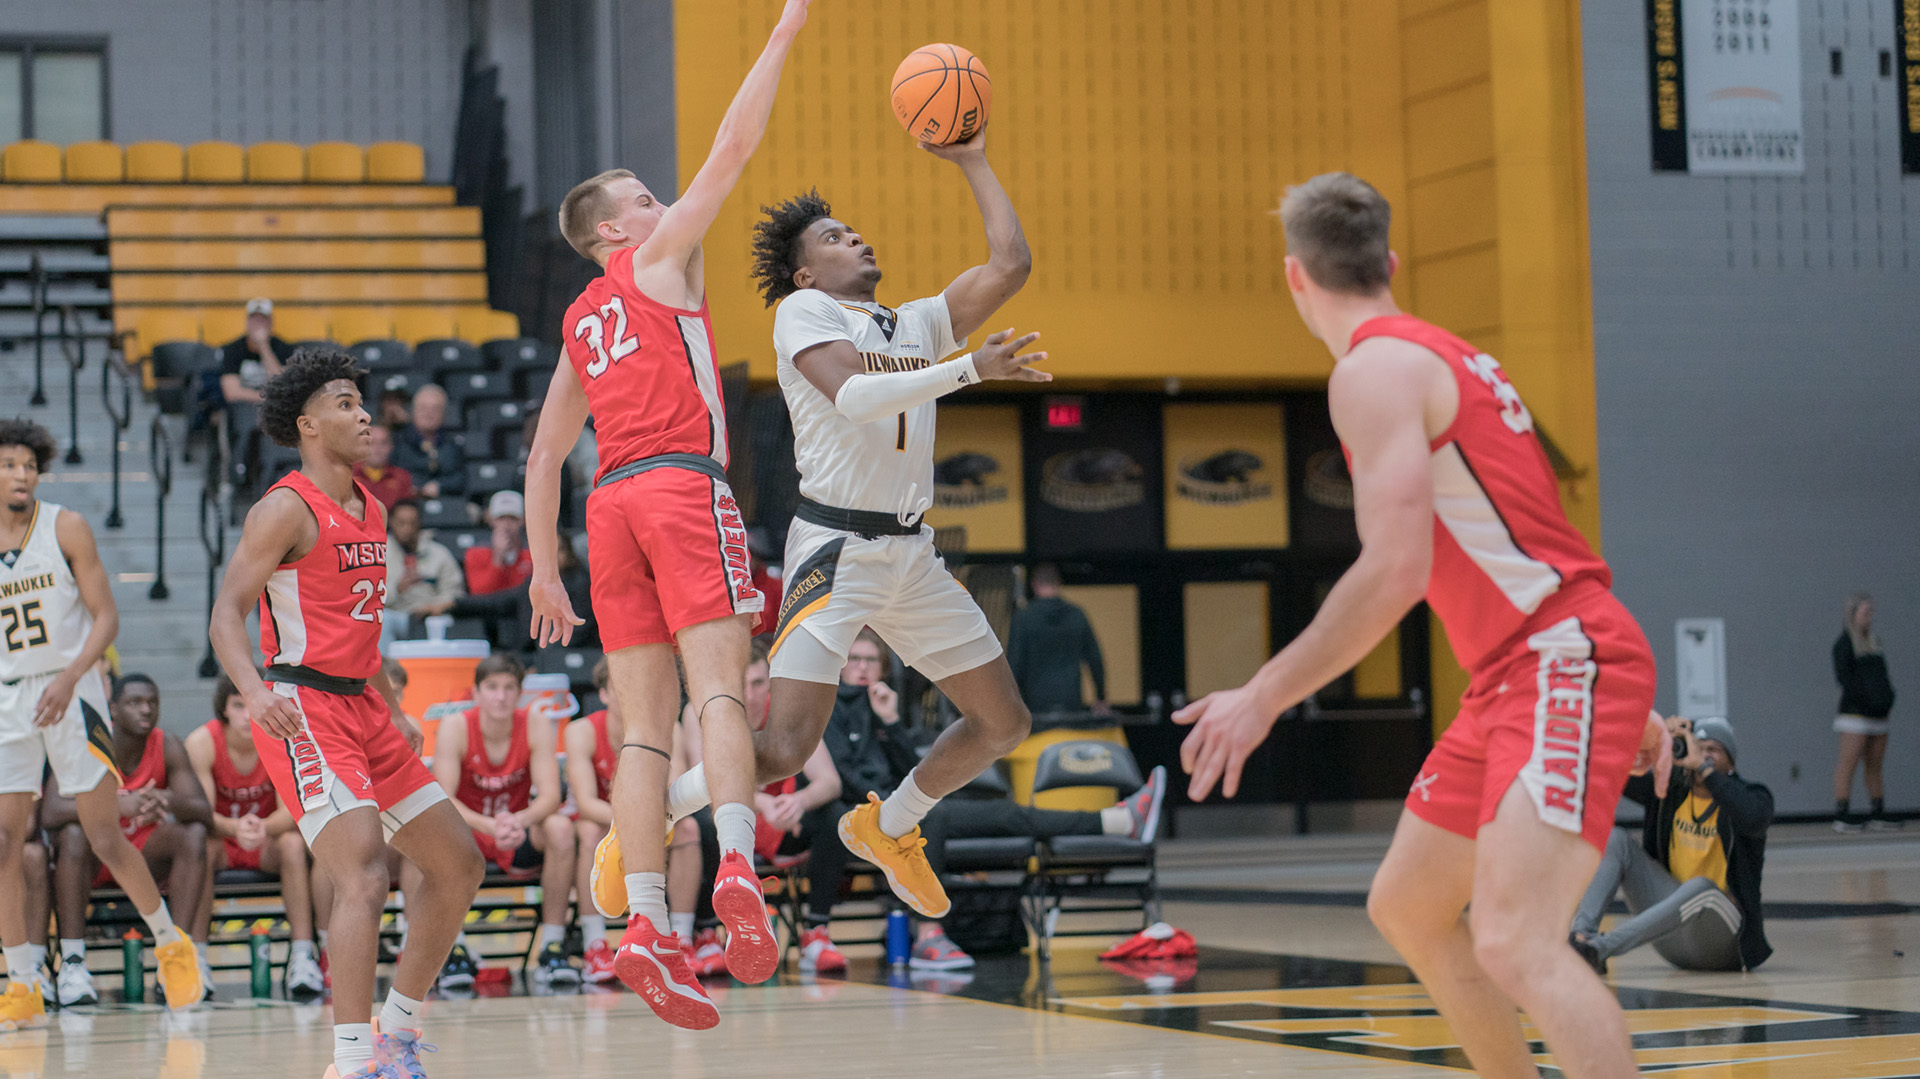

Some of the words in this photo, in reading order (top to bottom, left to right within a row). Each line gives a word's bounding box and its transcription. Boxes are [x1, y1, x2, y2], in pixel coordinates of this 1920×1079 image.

[1713, 32, 1770, 54] 2011
[1656, 60, 1678, 130] MEN'S
[574, 294, 642, 380] 32
[858, 351, 931, 373] ILWAUKE
[896, 411, 907, 453] 1
[0, 600, 50, 653] 25
[348, 576, 388, 624] 23
[775, 569, 827, 632] WAUKEE
[290, 730, 325, 802] RAIDE
